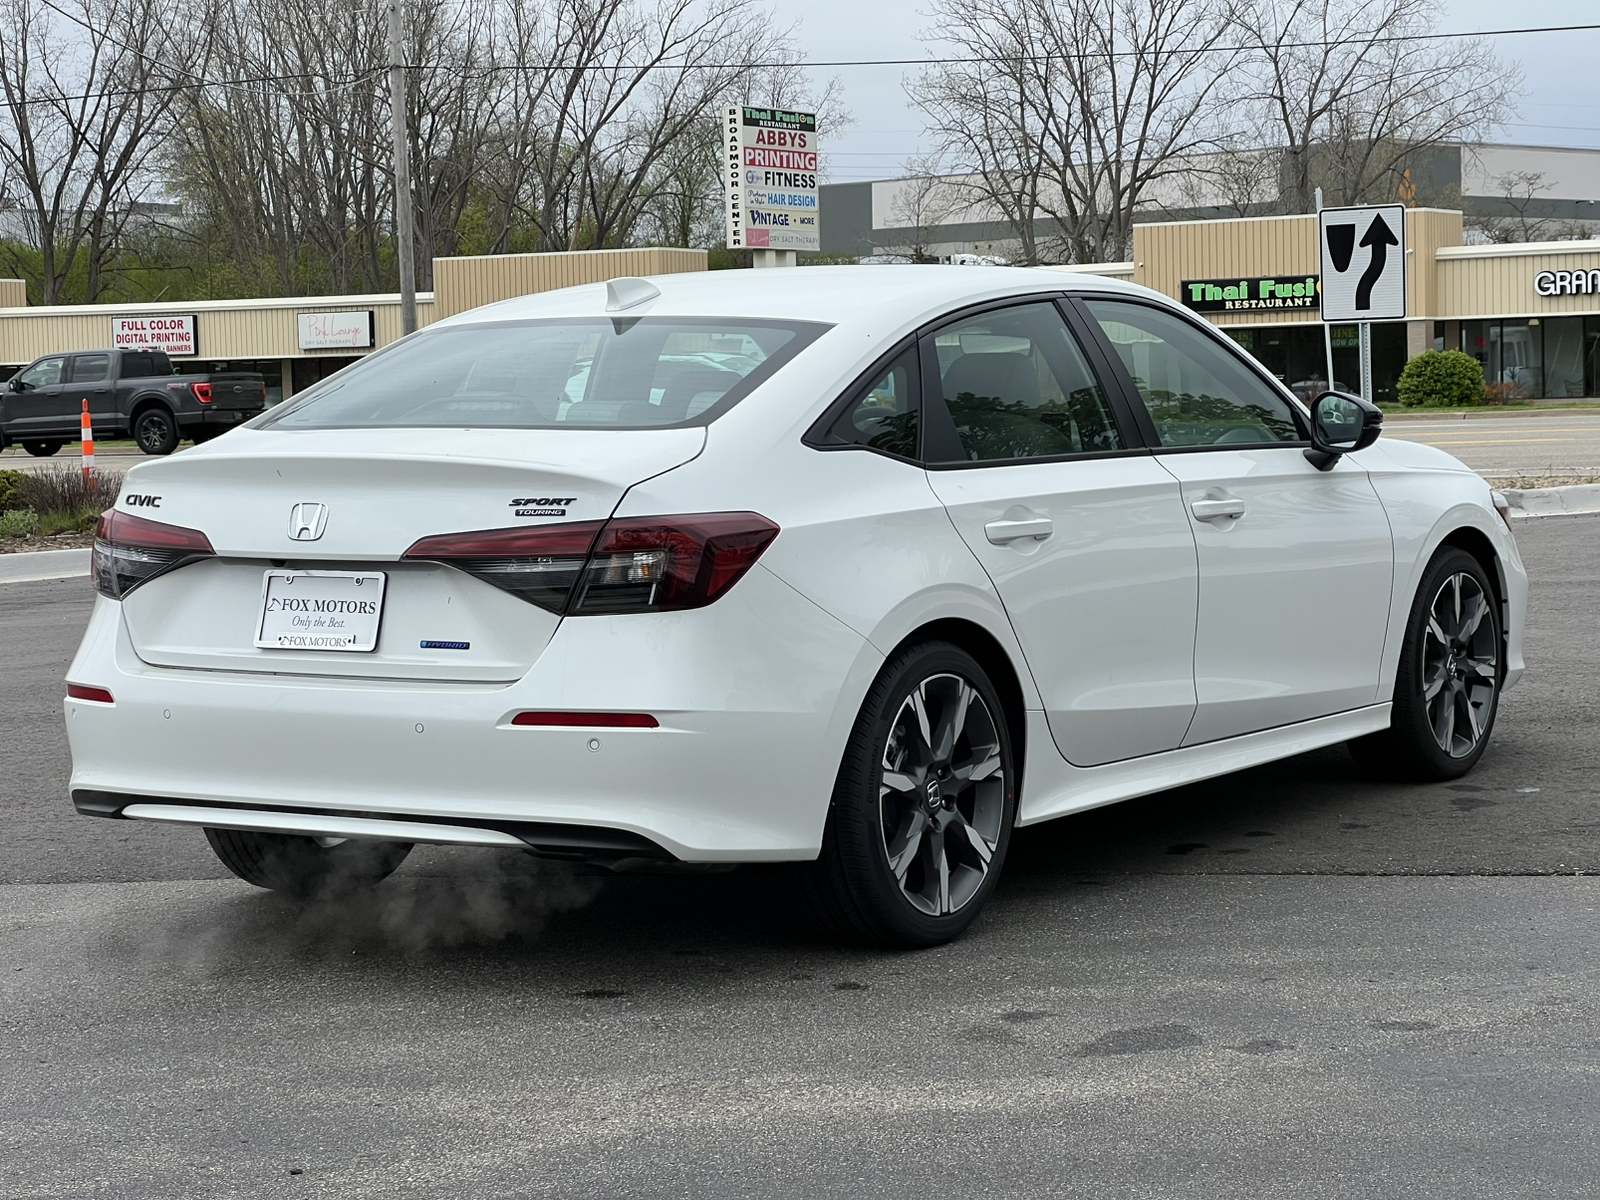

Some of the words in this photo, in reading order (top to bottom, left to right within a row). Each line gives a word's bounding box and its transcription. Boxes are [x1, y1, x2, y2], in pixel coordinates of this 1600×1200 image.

[744, 108, 771, 120] Thai
[775, 111, 814, 124] Fusion
[759, 120, 800, 130] RESTAURANT
[756, 129, 807, 148] ABBYS
[728, 109, 739, 187] BROADMOOR
[745, 148, 816, 170] PRINTING
[765, 171, 816, 189] FITNESS
[767, 193, 786, 205] HAIR
[788, 194, 816, 207] DESIGN
[731, 193, 741, 246] CENTER
[749, 210, 789, 226] VINTAGE
[800, 217, 814, 225] MORE
[796, 236, 818, 244] THERAPY
[1188, 281, 1248, 301] Thai
[1259, 278, 1320, 299] Fusi
[1534, 269, 1600, 296] GRAN
[1225, 298, 1312, 309] RESTAURANT
[121, 321, 146, 331] FULL
[149, 319, 184, 330] COLOR
[307, 314, 329, 339] Pink
[331, 314, 361, 345] Lounge
[116, 333, 149, 344] DIGITAL
[151, 332, 191, 343] PRINTING
[166, 344, 191, 352] BANNERS
[125, 494, 162, 508] CIVIC
[508, 498, 577, 506] SPORT
[281, 598, 311, 612] FOX
[313, 599, 376, 615] MOTORS
[291, 615, 312, 630] Only
[313, 616, 326, 627] the
[327, 617, 346, 628] Best.
[289, 636, 308, 646] FOX
[308, 636, 348, 647] MOTORS
